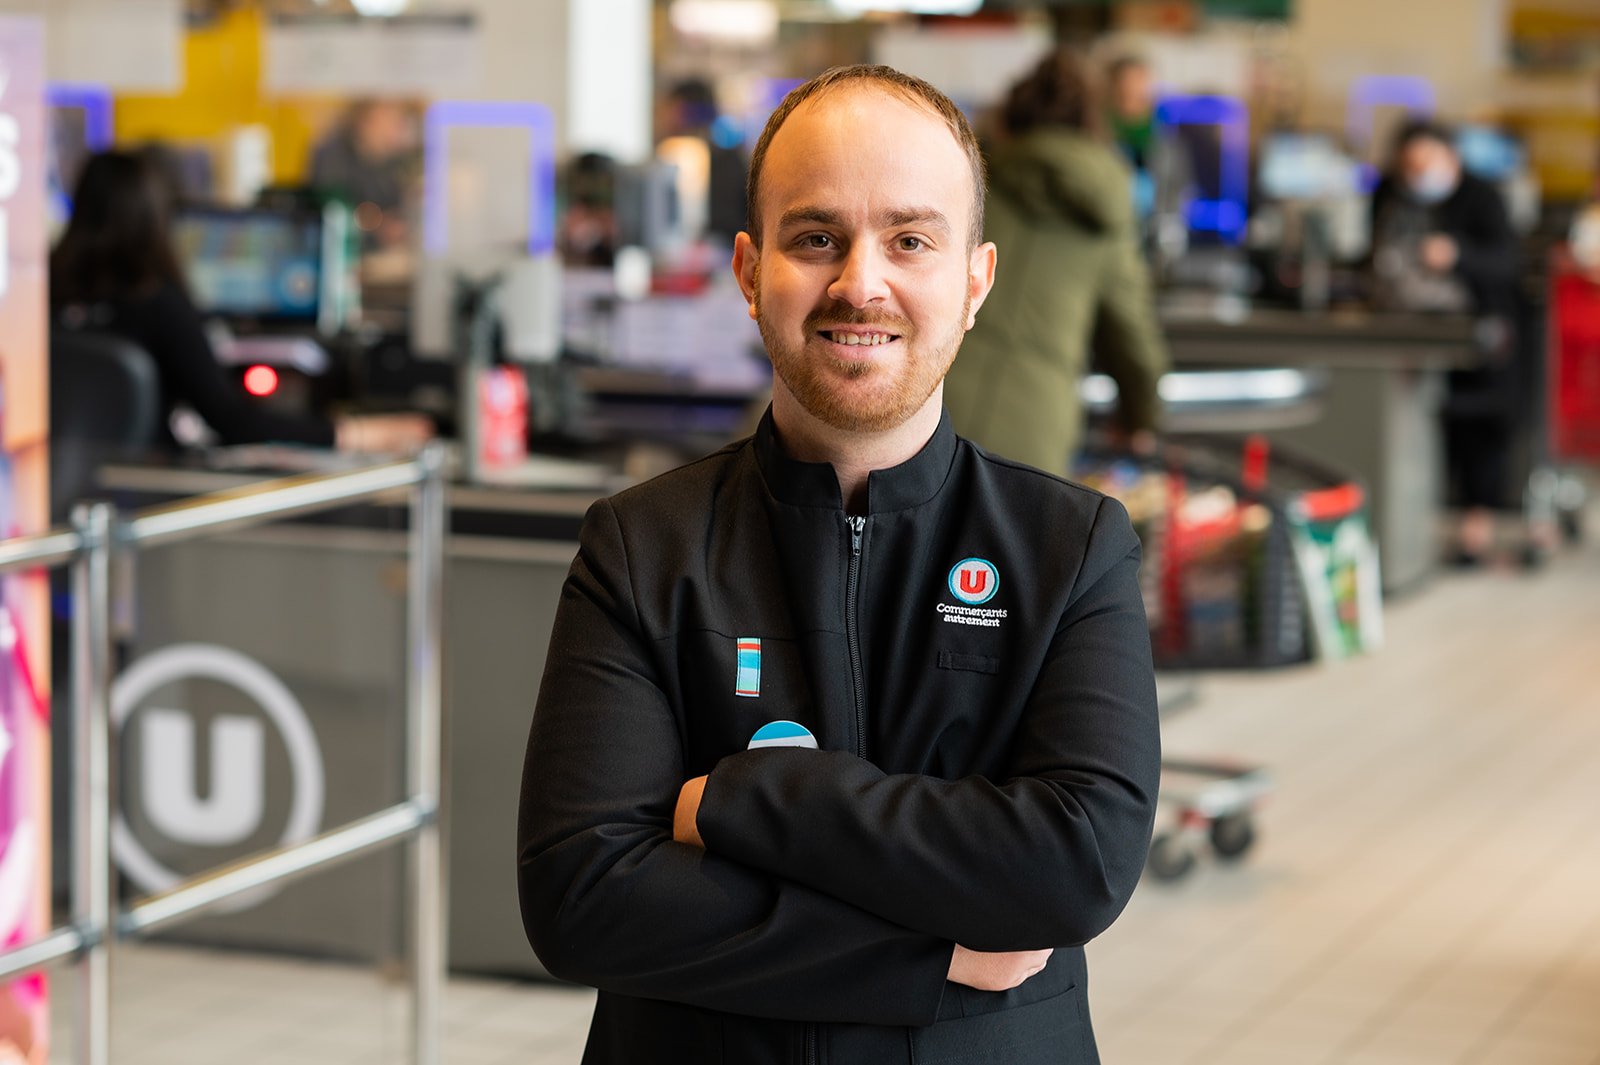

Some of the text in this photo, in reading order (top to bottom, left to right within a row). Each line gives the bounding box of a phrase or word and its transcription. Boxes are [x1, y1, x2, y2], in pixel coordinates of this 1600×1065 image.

[960, 570, 988, 594] U
[936, 602, 1008, 618] Commerçants
[943, 614, 1000, 627] autrement
[140, 709, 264, 845] U
